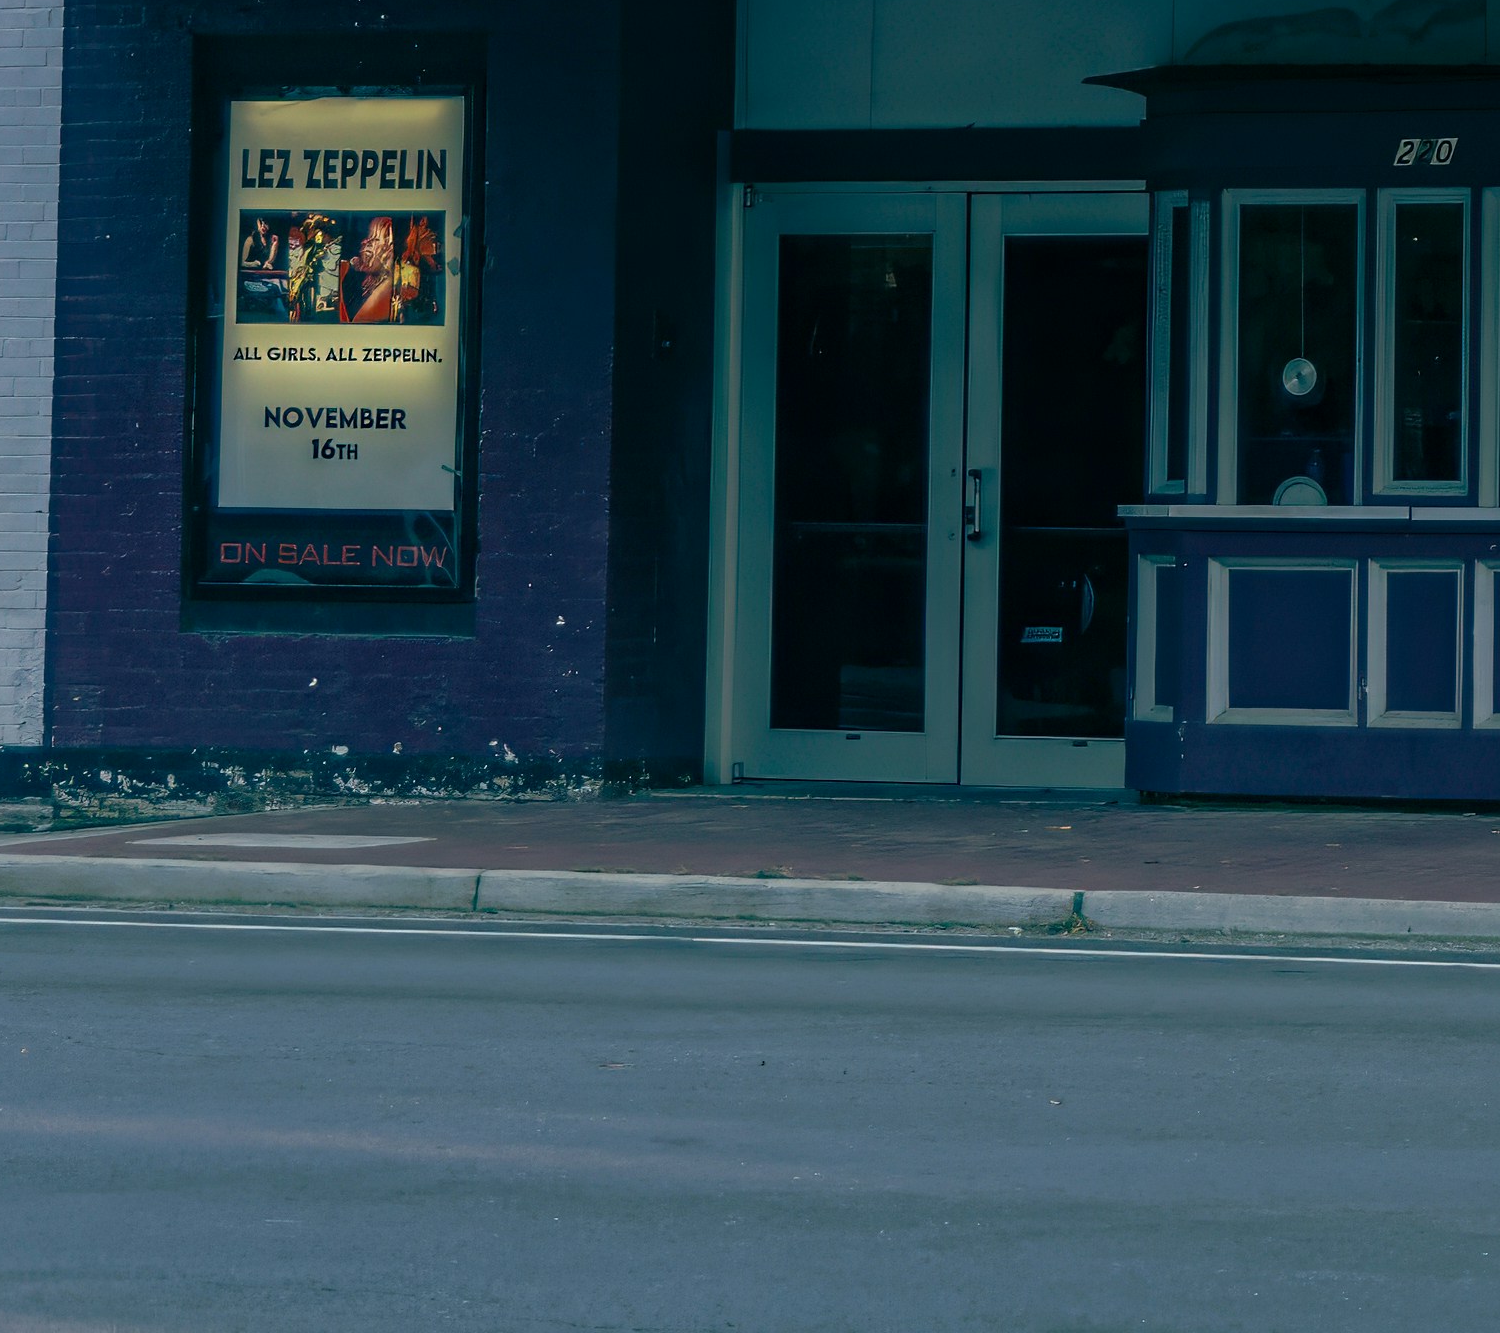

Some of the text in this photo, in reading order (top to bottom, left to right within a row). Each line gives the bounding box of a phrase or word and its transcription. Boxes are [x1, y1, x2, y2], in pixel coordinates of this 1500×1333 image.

[1396, 139, 1454, 165] 220
[240, 148, 447, 190] LEZ ZEPPELIN
[233, 347, 443, 363] ALL GIRLS. ALL ZEPPELIN.
[263, 406, 407, 430] NOVEMBER
[310, 438, 359, 460] 16TH
[221, 542, 447, 569] ON SALE NOW
